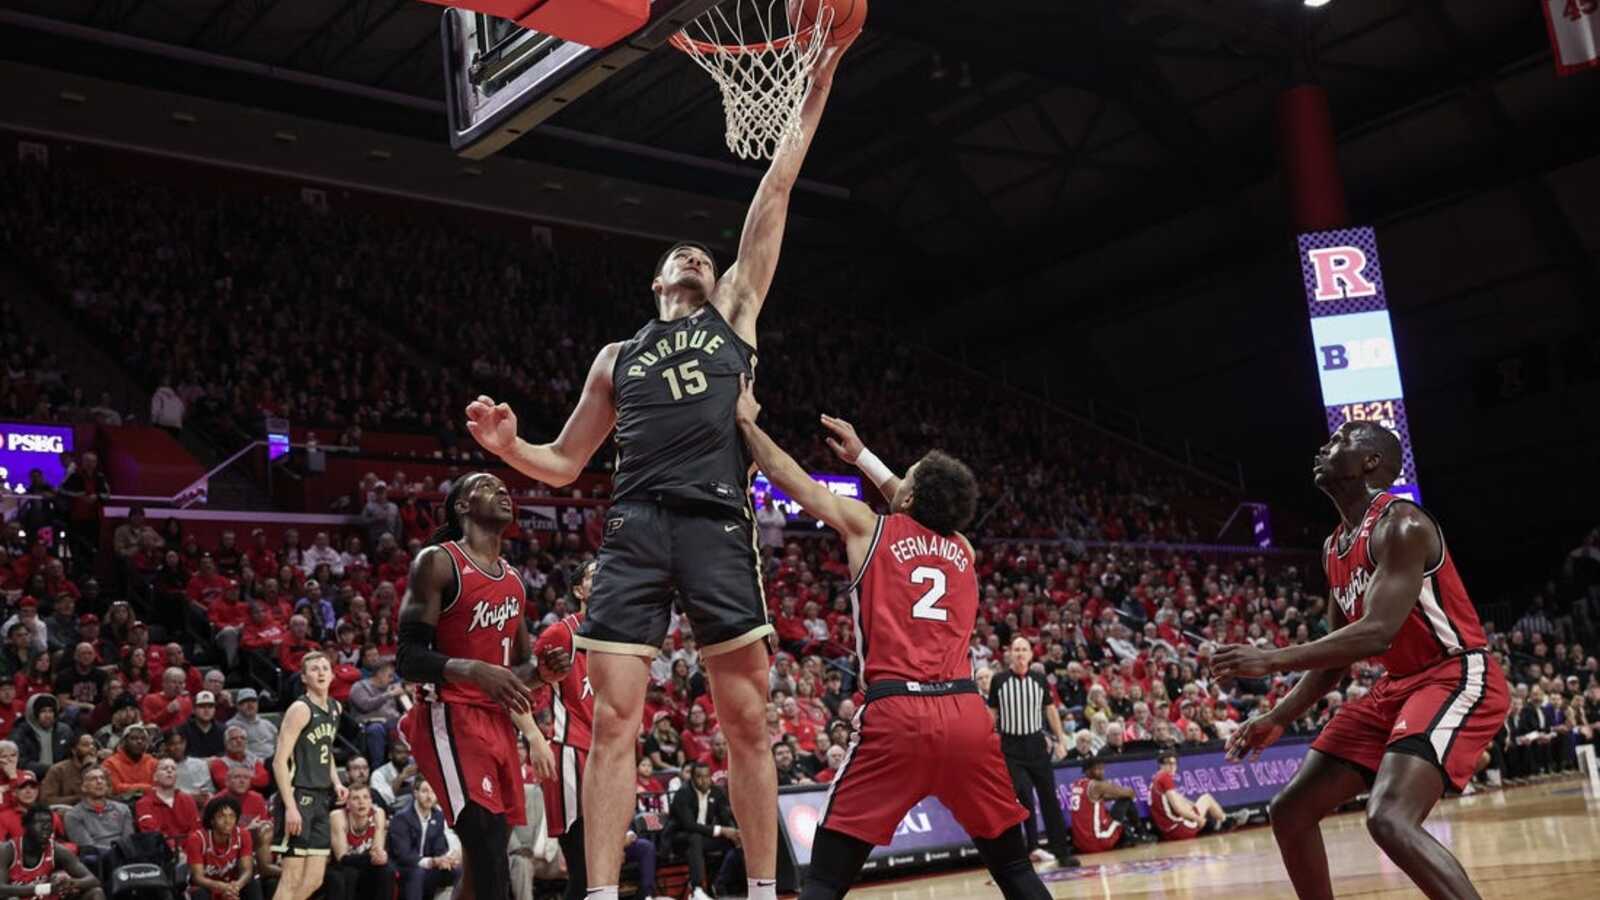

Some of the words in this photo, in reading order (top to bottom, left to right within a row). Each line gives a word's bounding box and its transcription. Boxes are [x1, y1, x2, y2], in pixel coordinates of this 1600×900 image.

[1308, 246, 1377, 301] R
[627, 330, 725, 377] PURDUE
[662, 359, 709, 401] 15
[1341, 400, 1395, 422] 15:21
[890, 535, 969, 573] FERNANDES
[910, 566, 948, 622] 2
[501, 637, 513, 666] 1
[320, 744, 329, 764] 2
